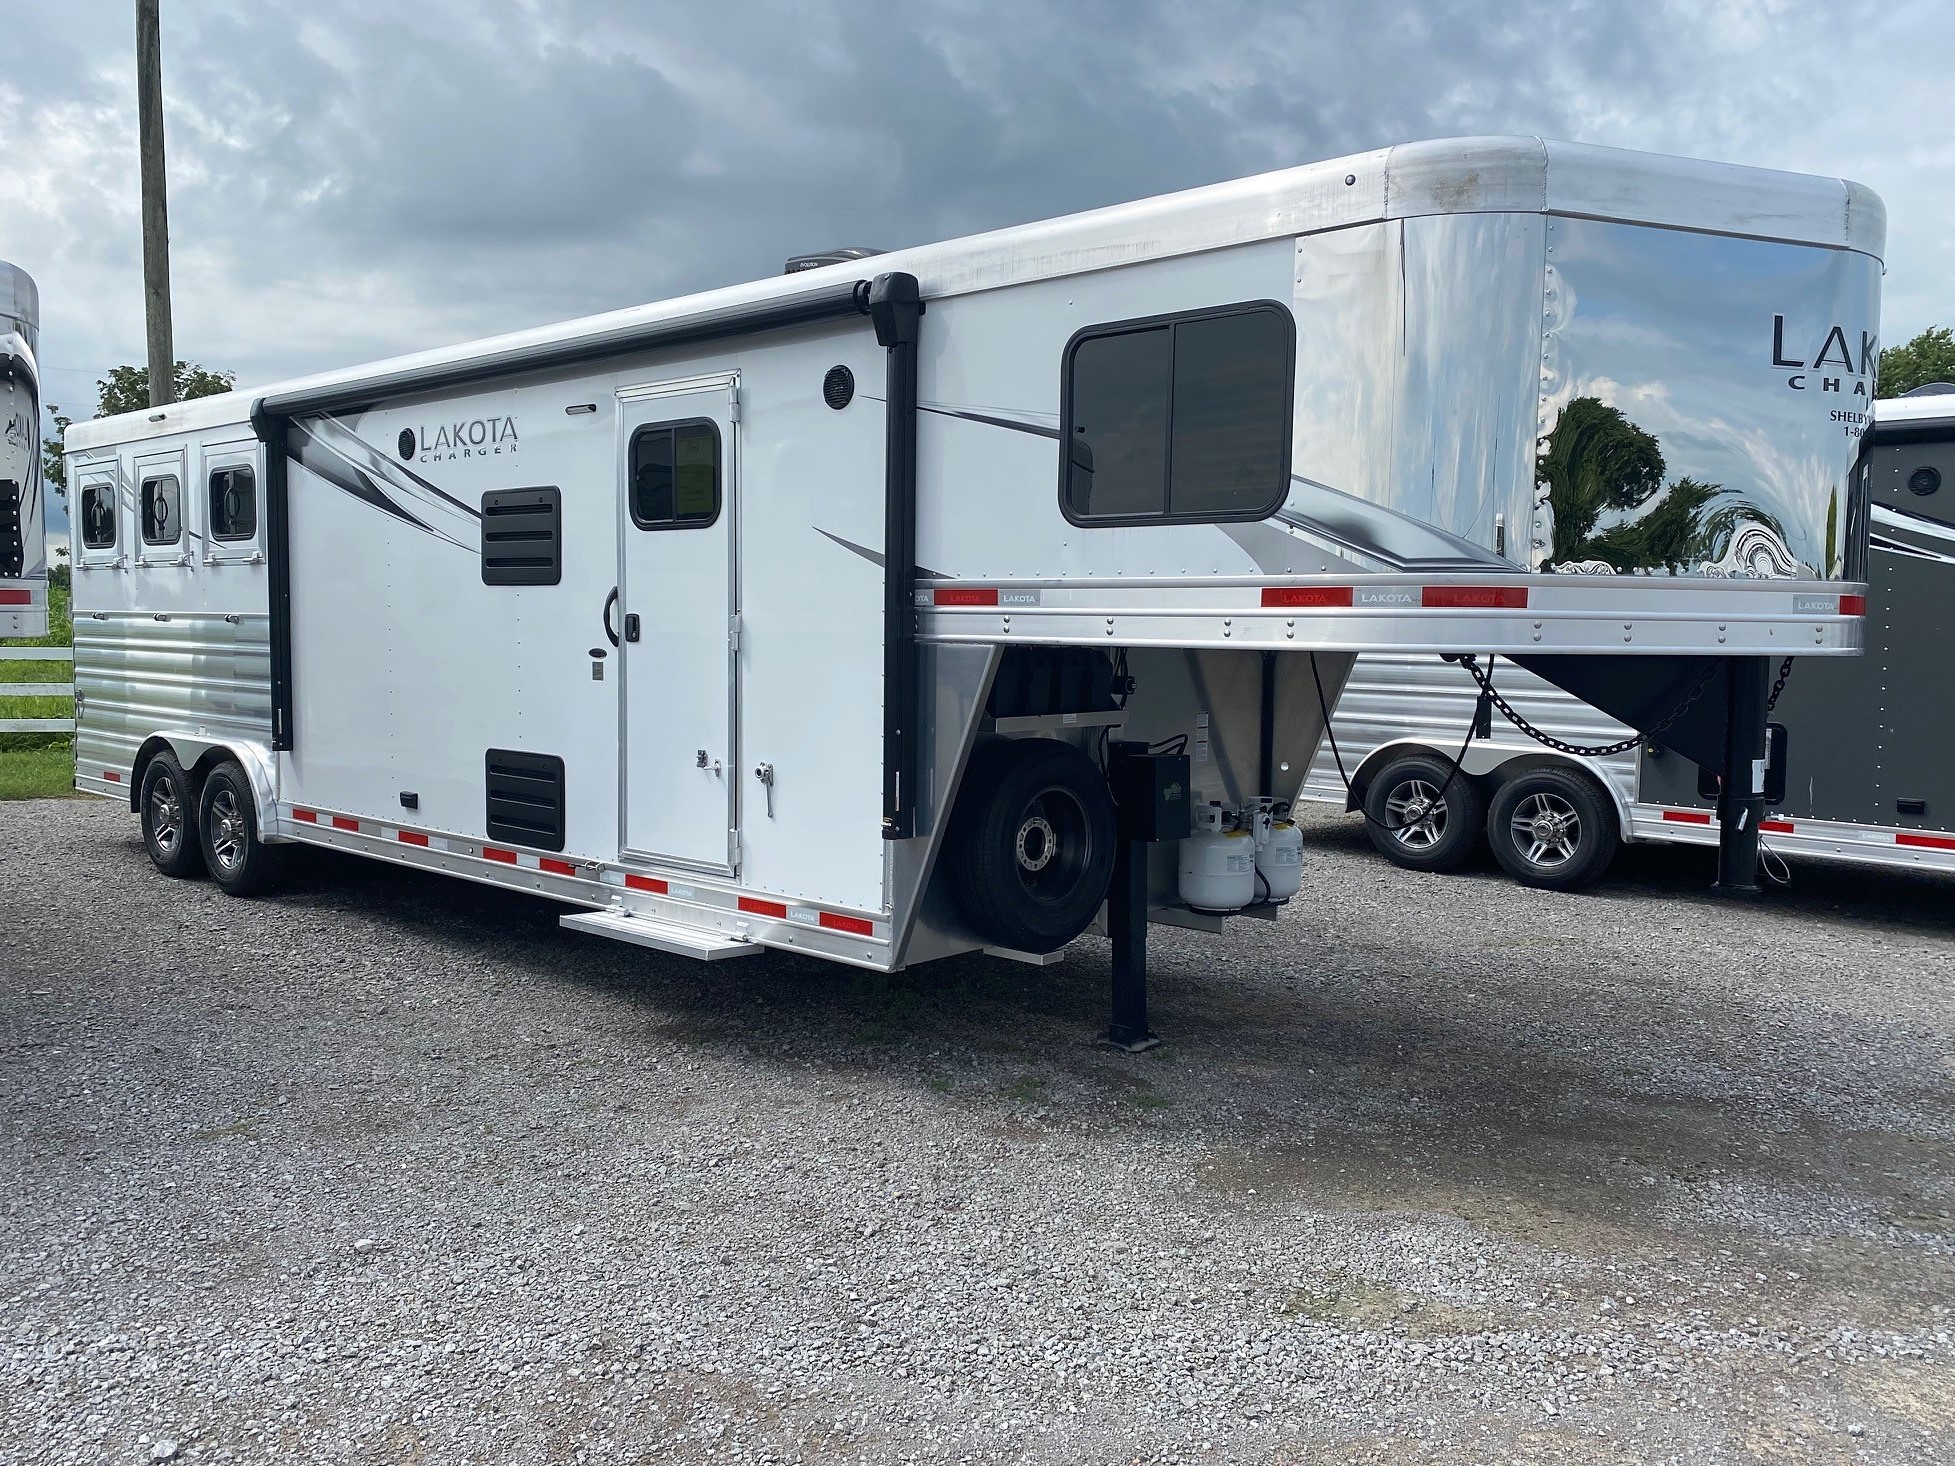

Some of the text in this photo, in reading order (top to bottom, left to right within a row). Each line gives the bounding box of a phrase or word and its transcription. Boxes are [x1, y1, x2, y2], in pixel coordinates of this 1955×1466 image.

[1772, 314, 1877, 377] LAK
[420, 416, 519, 452] LAKOTA
[420, 443, 518, 463] CHARGER
[914, 595, 929, 603] OTA
[950, 594, 981, 603] LAKOTA
[1003, 594, 1036, 603] LAKOTA
[1283, 592, 1328, 603] LAKOTA
[1361, 592, 1412, 603] LAKOTA
[1453, 592, 1505, 604] LAKOTA
[1798, 601, 1834, 610] LAKOTA
[790, 911, 816, 922] LAKOTA
